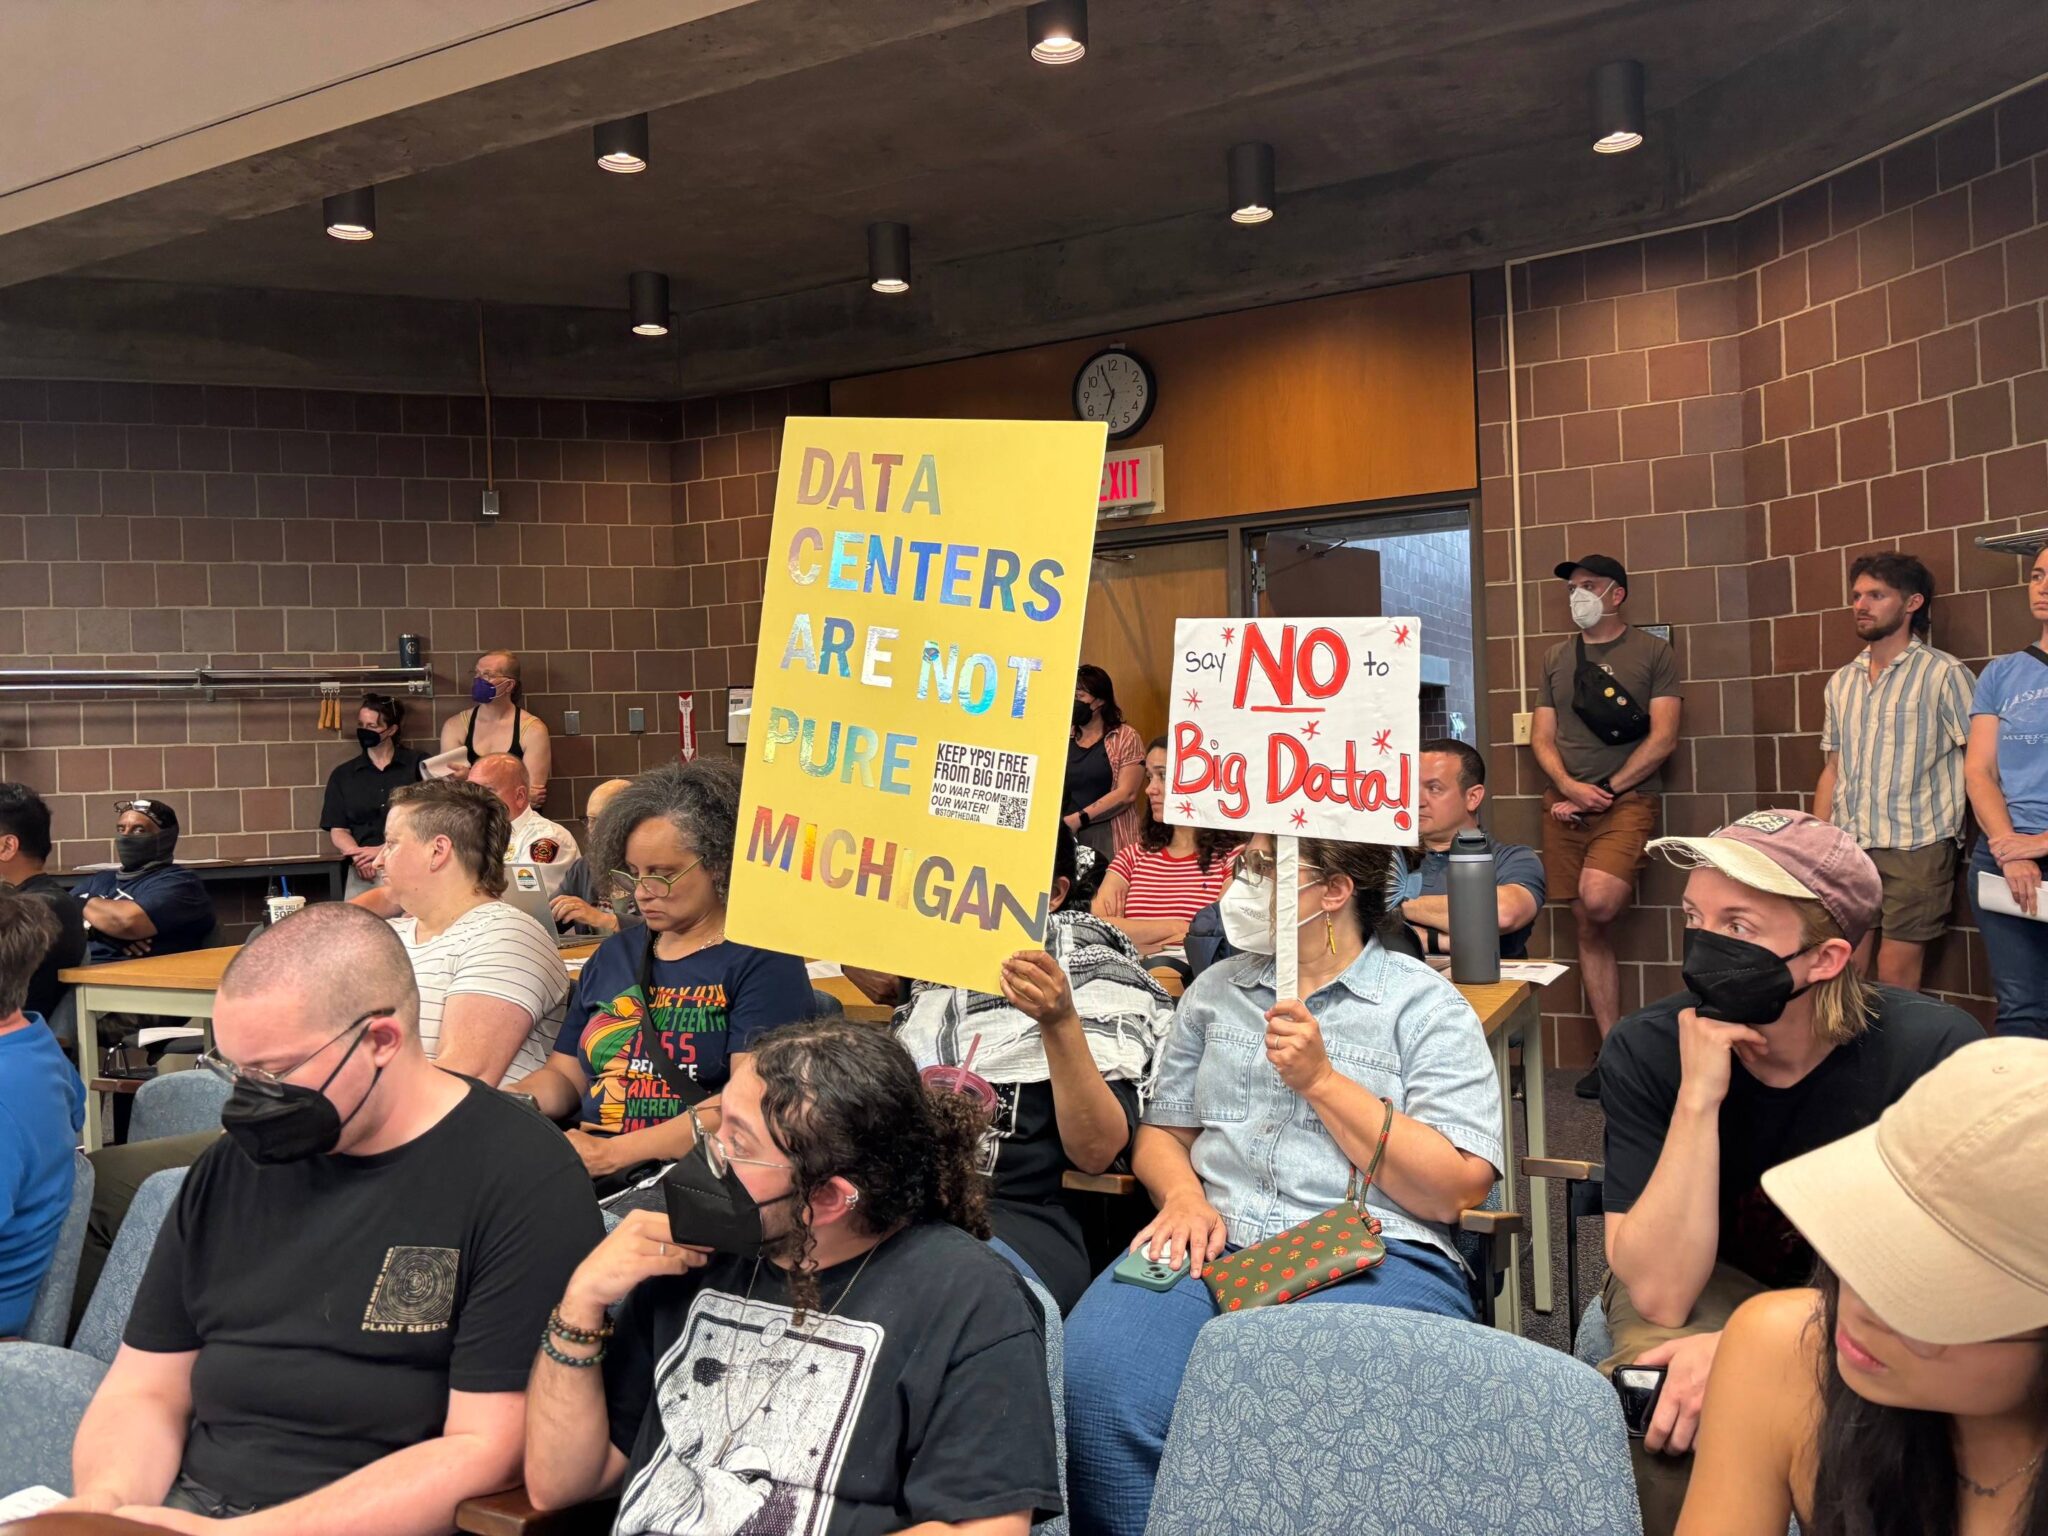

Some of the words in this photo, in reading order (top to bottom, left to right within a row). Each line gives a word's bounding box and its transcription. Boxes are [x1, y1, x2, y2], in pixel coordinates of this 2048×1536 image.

[1107, 359, 1118, 371] 12
[1088, 376, 1098, 388] 10
[1131, 370, 1140, 383] 2
[1083, 391, 1090, 404] 9
[1136, 385, 1144, 397] 3
[1087, 404, 1095, 417] 8
[1131, 400, 1139, 411] 4
[1111, 416, 1118, 429] 6
[1123, 411, 1130, 424] 5
[796, 447, 941, 515] DATA
[787, 526, 1065, 622] CENTERS
[780, 613, 900, 688] ARE
[916, 640, 1043, 719] NOT
[1233, 622, 1351, 709] NO
[1363, 651, 1390, 676] to
[762, 707, 918, 795] PURE
[936, 743, 967, 764] KEEP
[970, 748, 996, 769] YPSI
[997, 752, 1029, 774] FREE
[934, 761, 970, 784] FROM
[972, 767, 993, 787] BIG
[995, 771, 1031, 793] DATA!
[1171, 720, 1250, 819] Big
[1266, 733, 1412, 831] Data!
[932, 782, 947, 794] NO
[948, 784, 971, 798] WAR
[971, 789, 1001, 803] FROM
[931, 795, 952, 807] OUR
[953, 799, 990, 814] WATER!
[935, 807, 980, 823] @STOPTHEDATA
[746, 805, 1049, 943] MICHIGAN
[361, 1322, 405, 1333] PLANT
[407, 1320, 449, 1333] SEEDS
